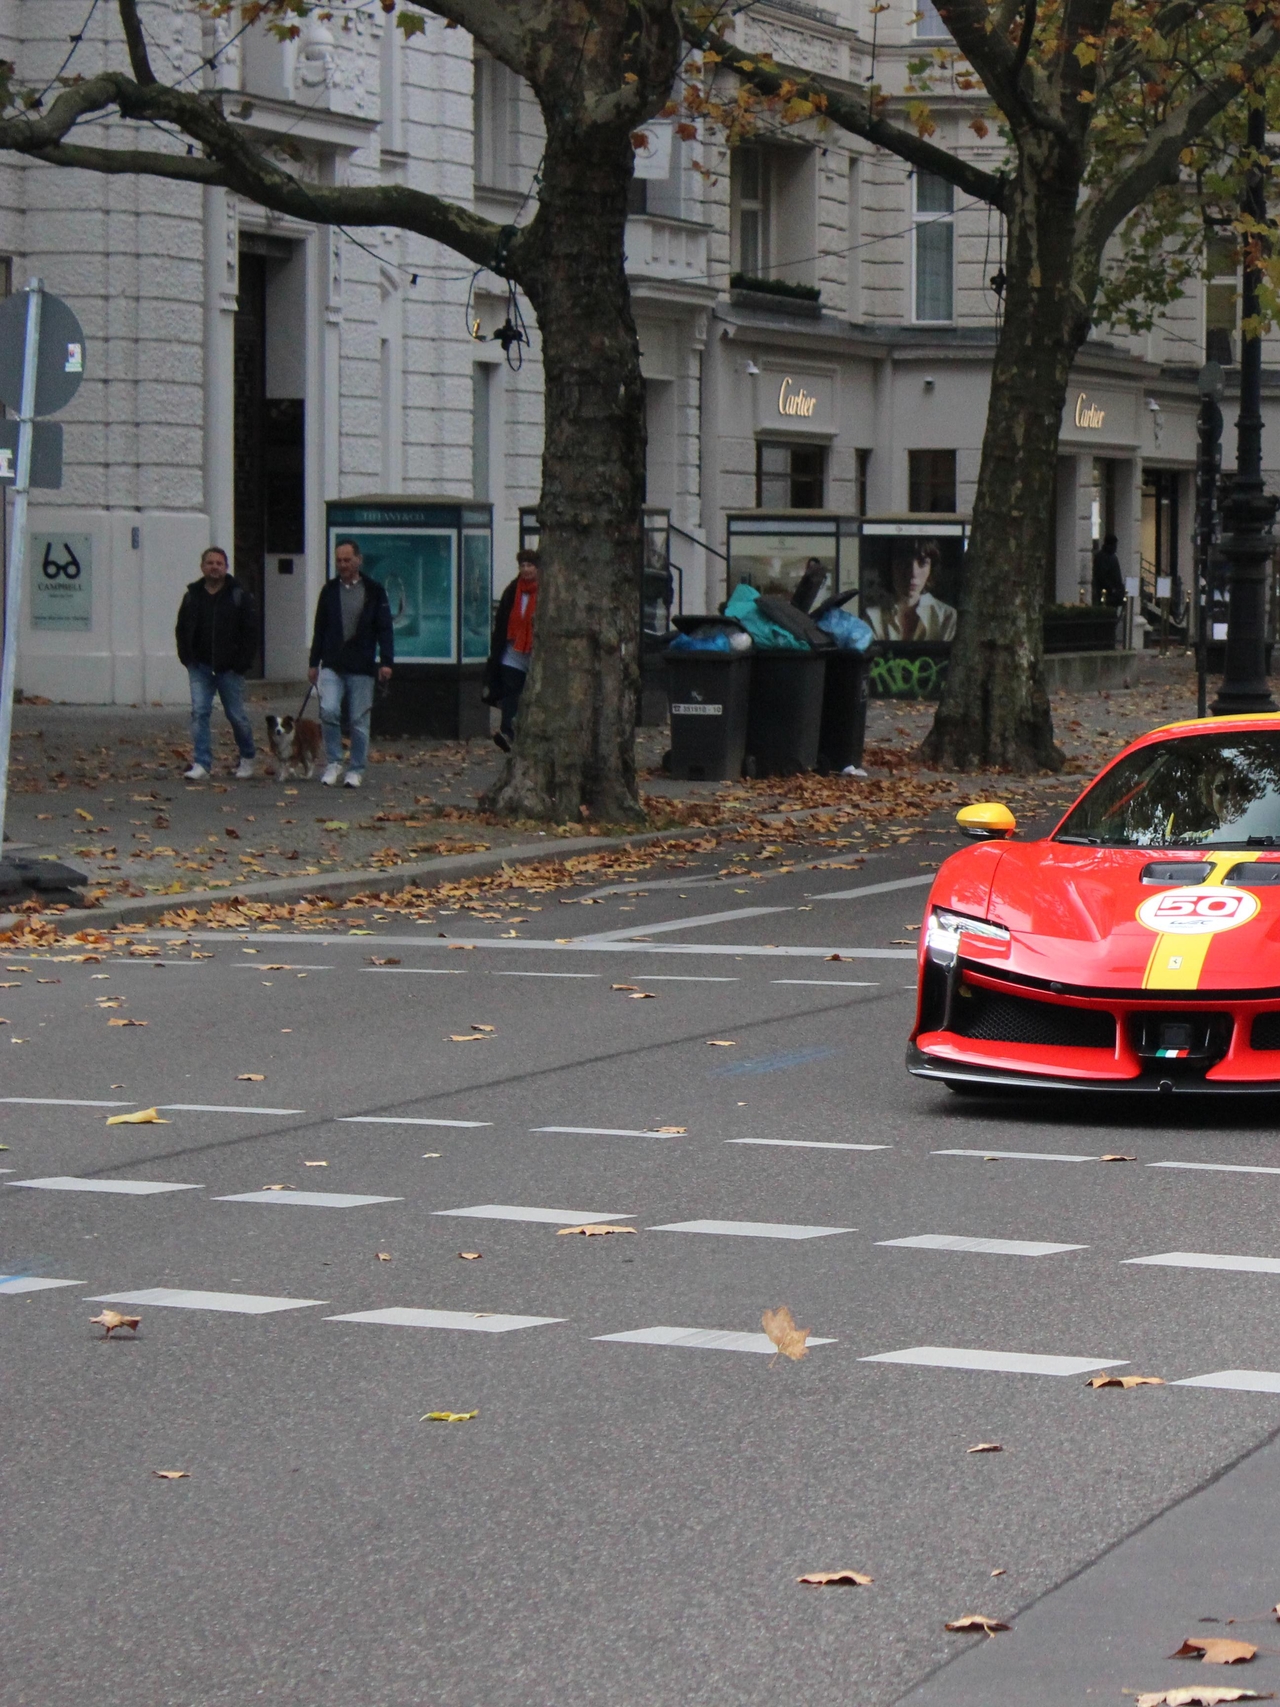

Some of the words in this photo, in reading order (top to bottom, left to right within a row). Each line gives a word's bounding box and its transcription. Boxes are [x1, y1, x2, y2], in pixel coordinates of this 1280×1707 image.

[779, 377, 816, 417] Cartier
[1076, 393, 1105, 428] Cartier
[1156, 896, 1239, 916] 50
